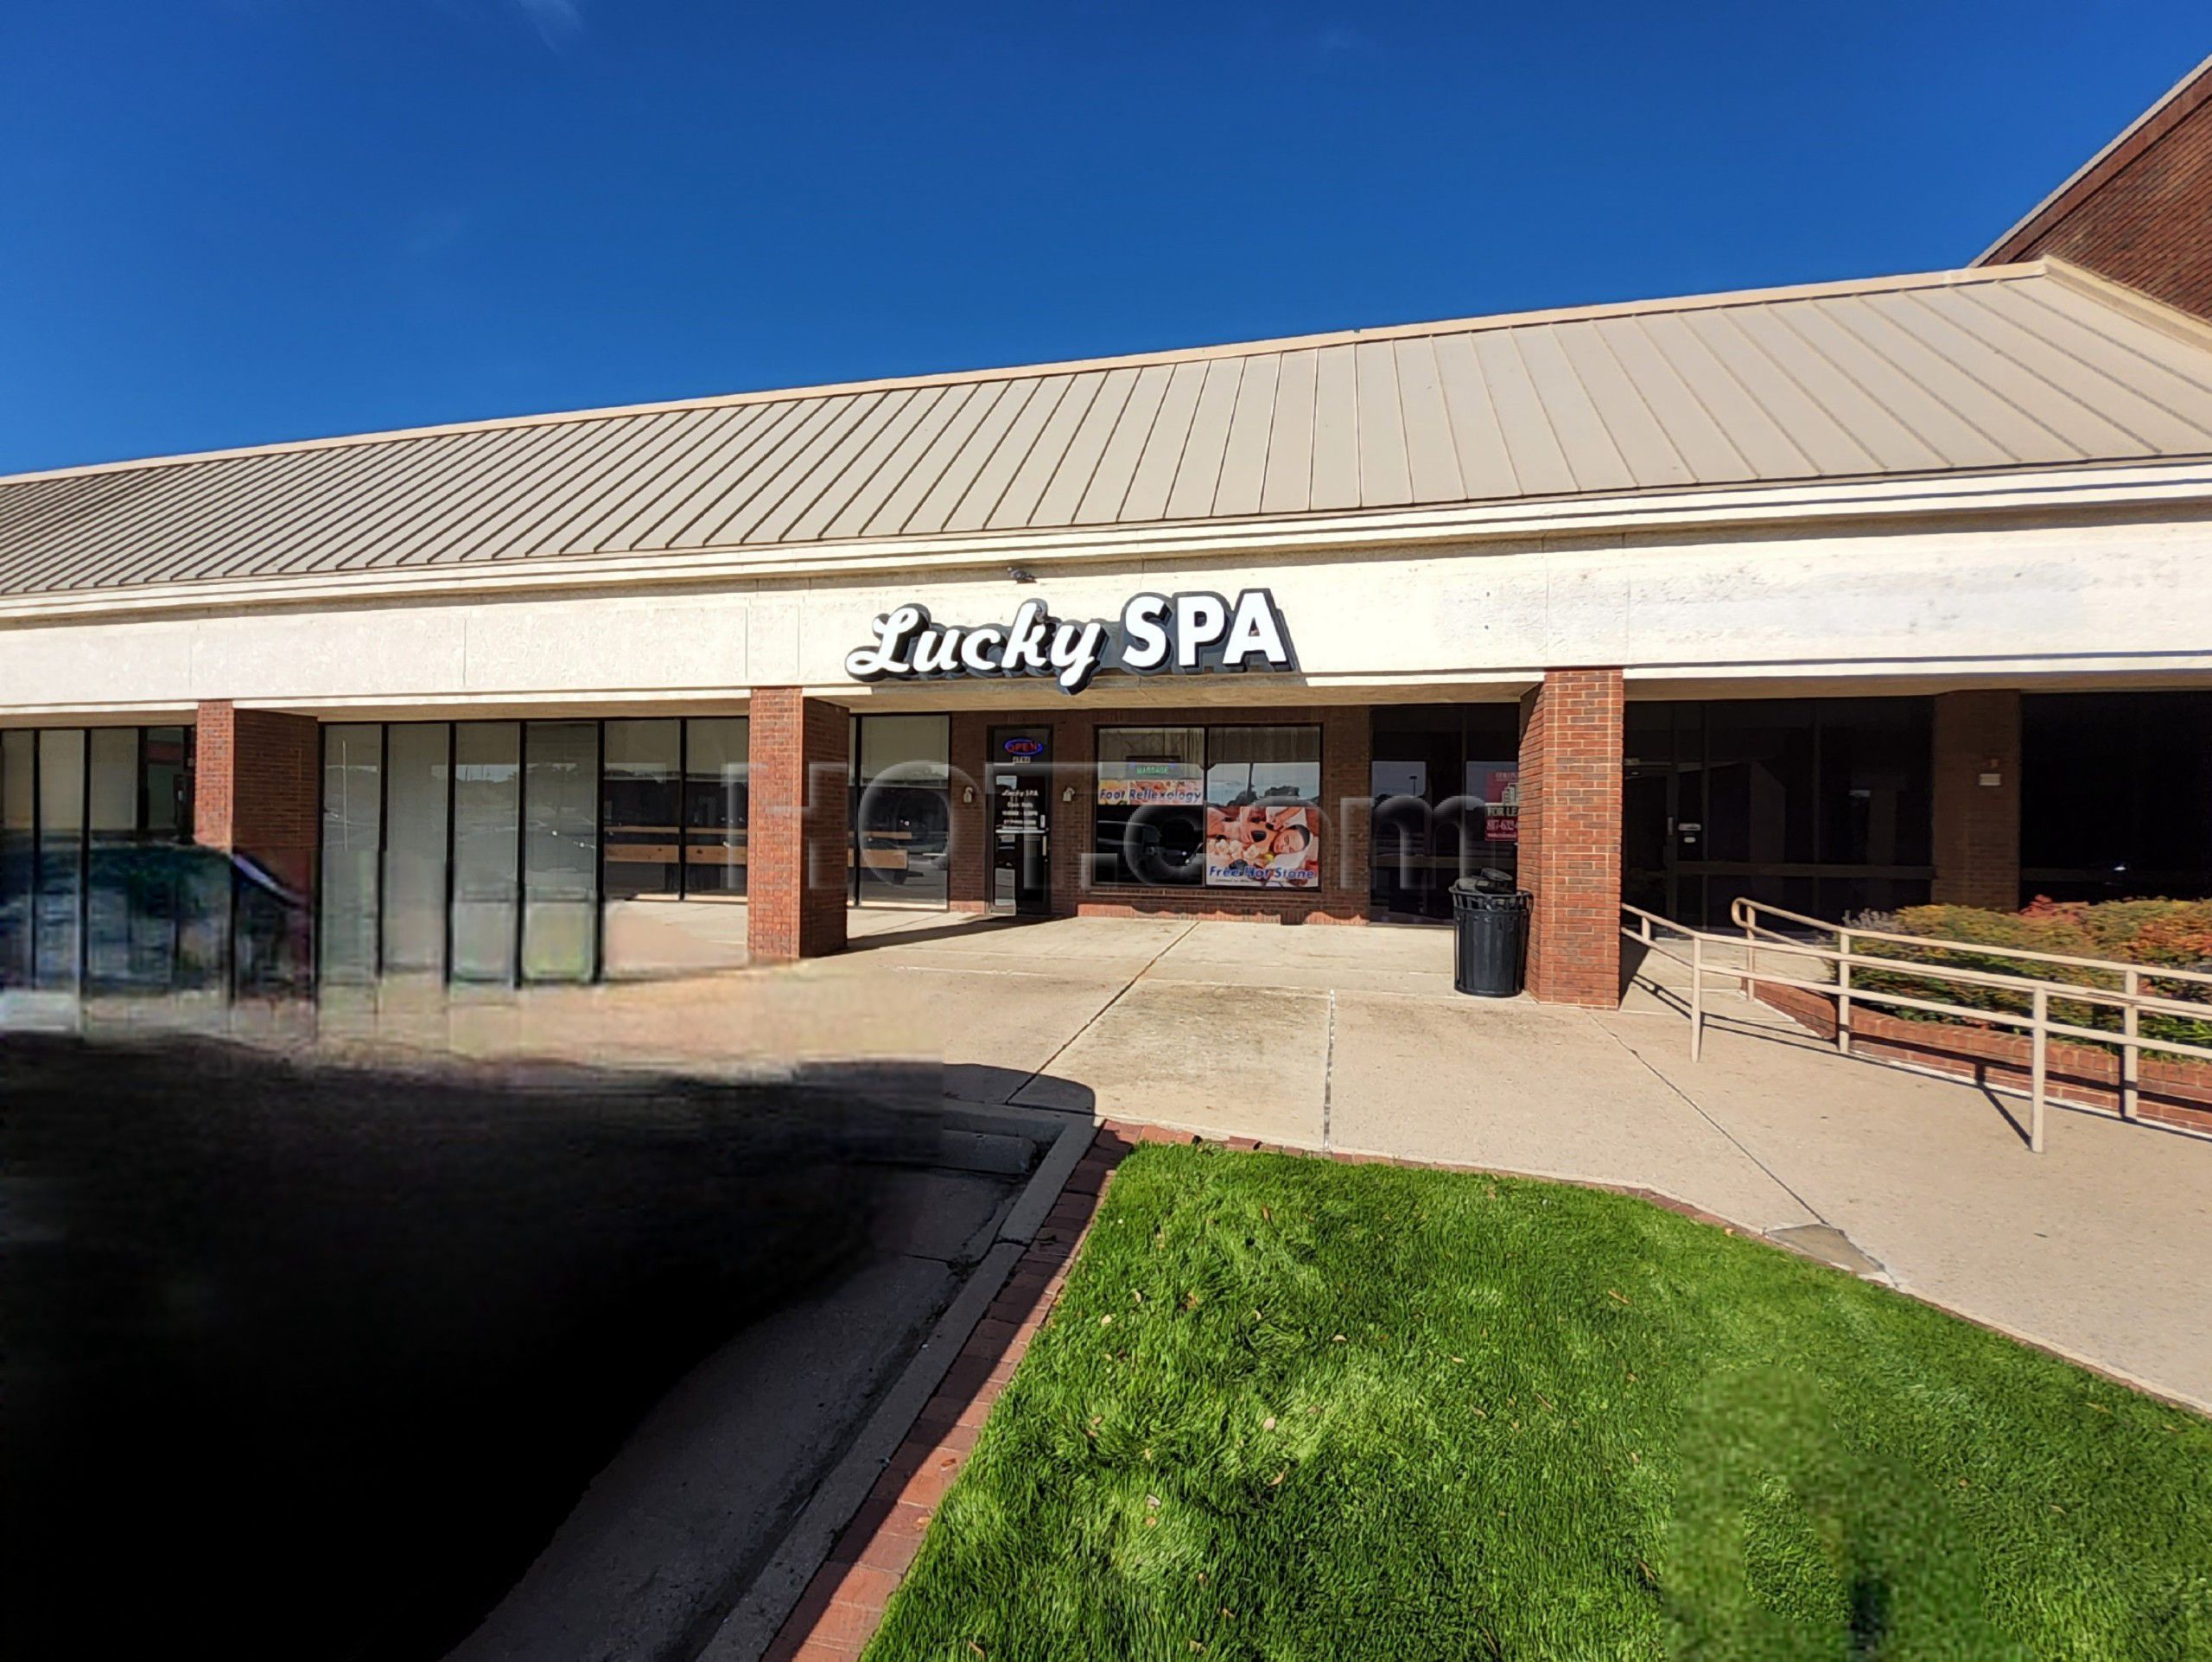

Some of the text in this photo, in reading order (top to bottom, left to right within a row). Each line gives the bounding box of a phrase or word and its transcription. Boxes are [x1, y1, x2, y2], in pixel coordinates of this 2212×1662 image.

[845, 591, 1293, 691] Lucky SPA
[1007, 742, 1039, 754] OPEN
[1099, 787, 1202, 803] Foot Reflexology
[1487, 806, 1519, 817] FOR LE
[1209, 865, 1315, 879] Free Hot Stone
